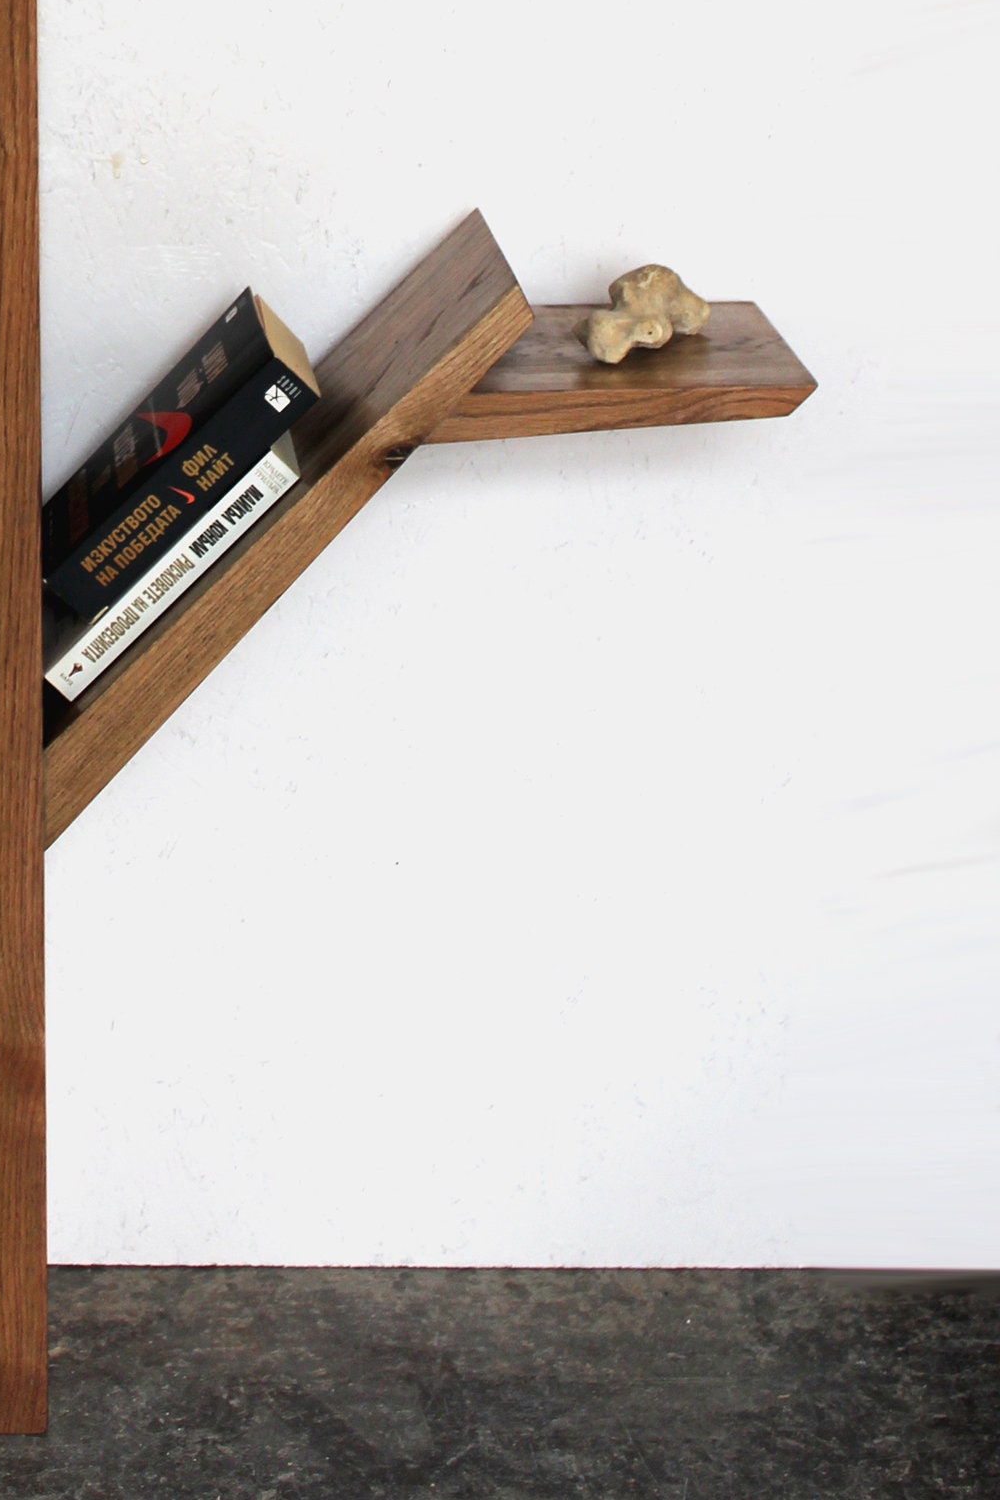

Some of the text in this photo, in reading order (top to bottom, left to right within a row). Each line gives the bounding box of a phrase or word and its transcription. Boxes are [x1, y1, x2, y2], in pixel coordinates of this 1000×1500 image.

[182, 444, 217, 476] ФИЛ
[196, 453, 234, 490] НАЙТ
[221, 485, 264, 525] МАЙКЪЛ
[81, 495, 160, 572] ИЗКУСТВОТО
[96, 566, 118, 586] НА
[114, 505, 181, 568] ПОБЕДАТА
[189, 520, 228, 558] КОНЪЛИ
[82, 607, 140, 663] ПРОФЕСИЯТА
